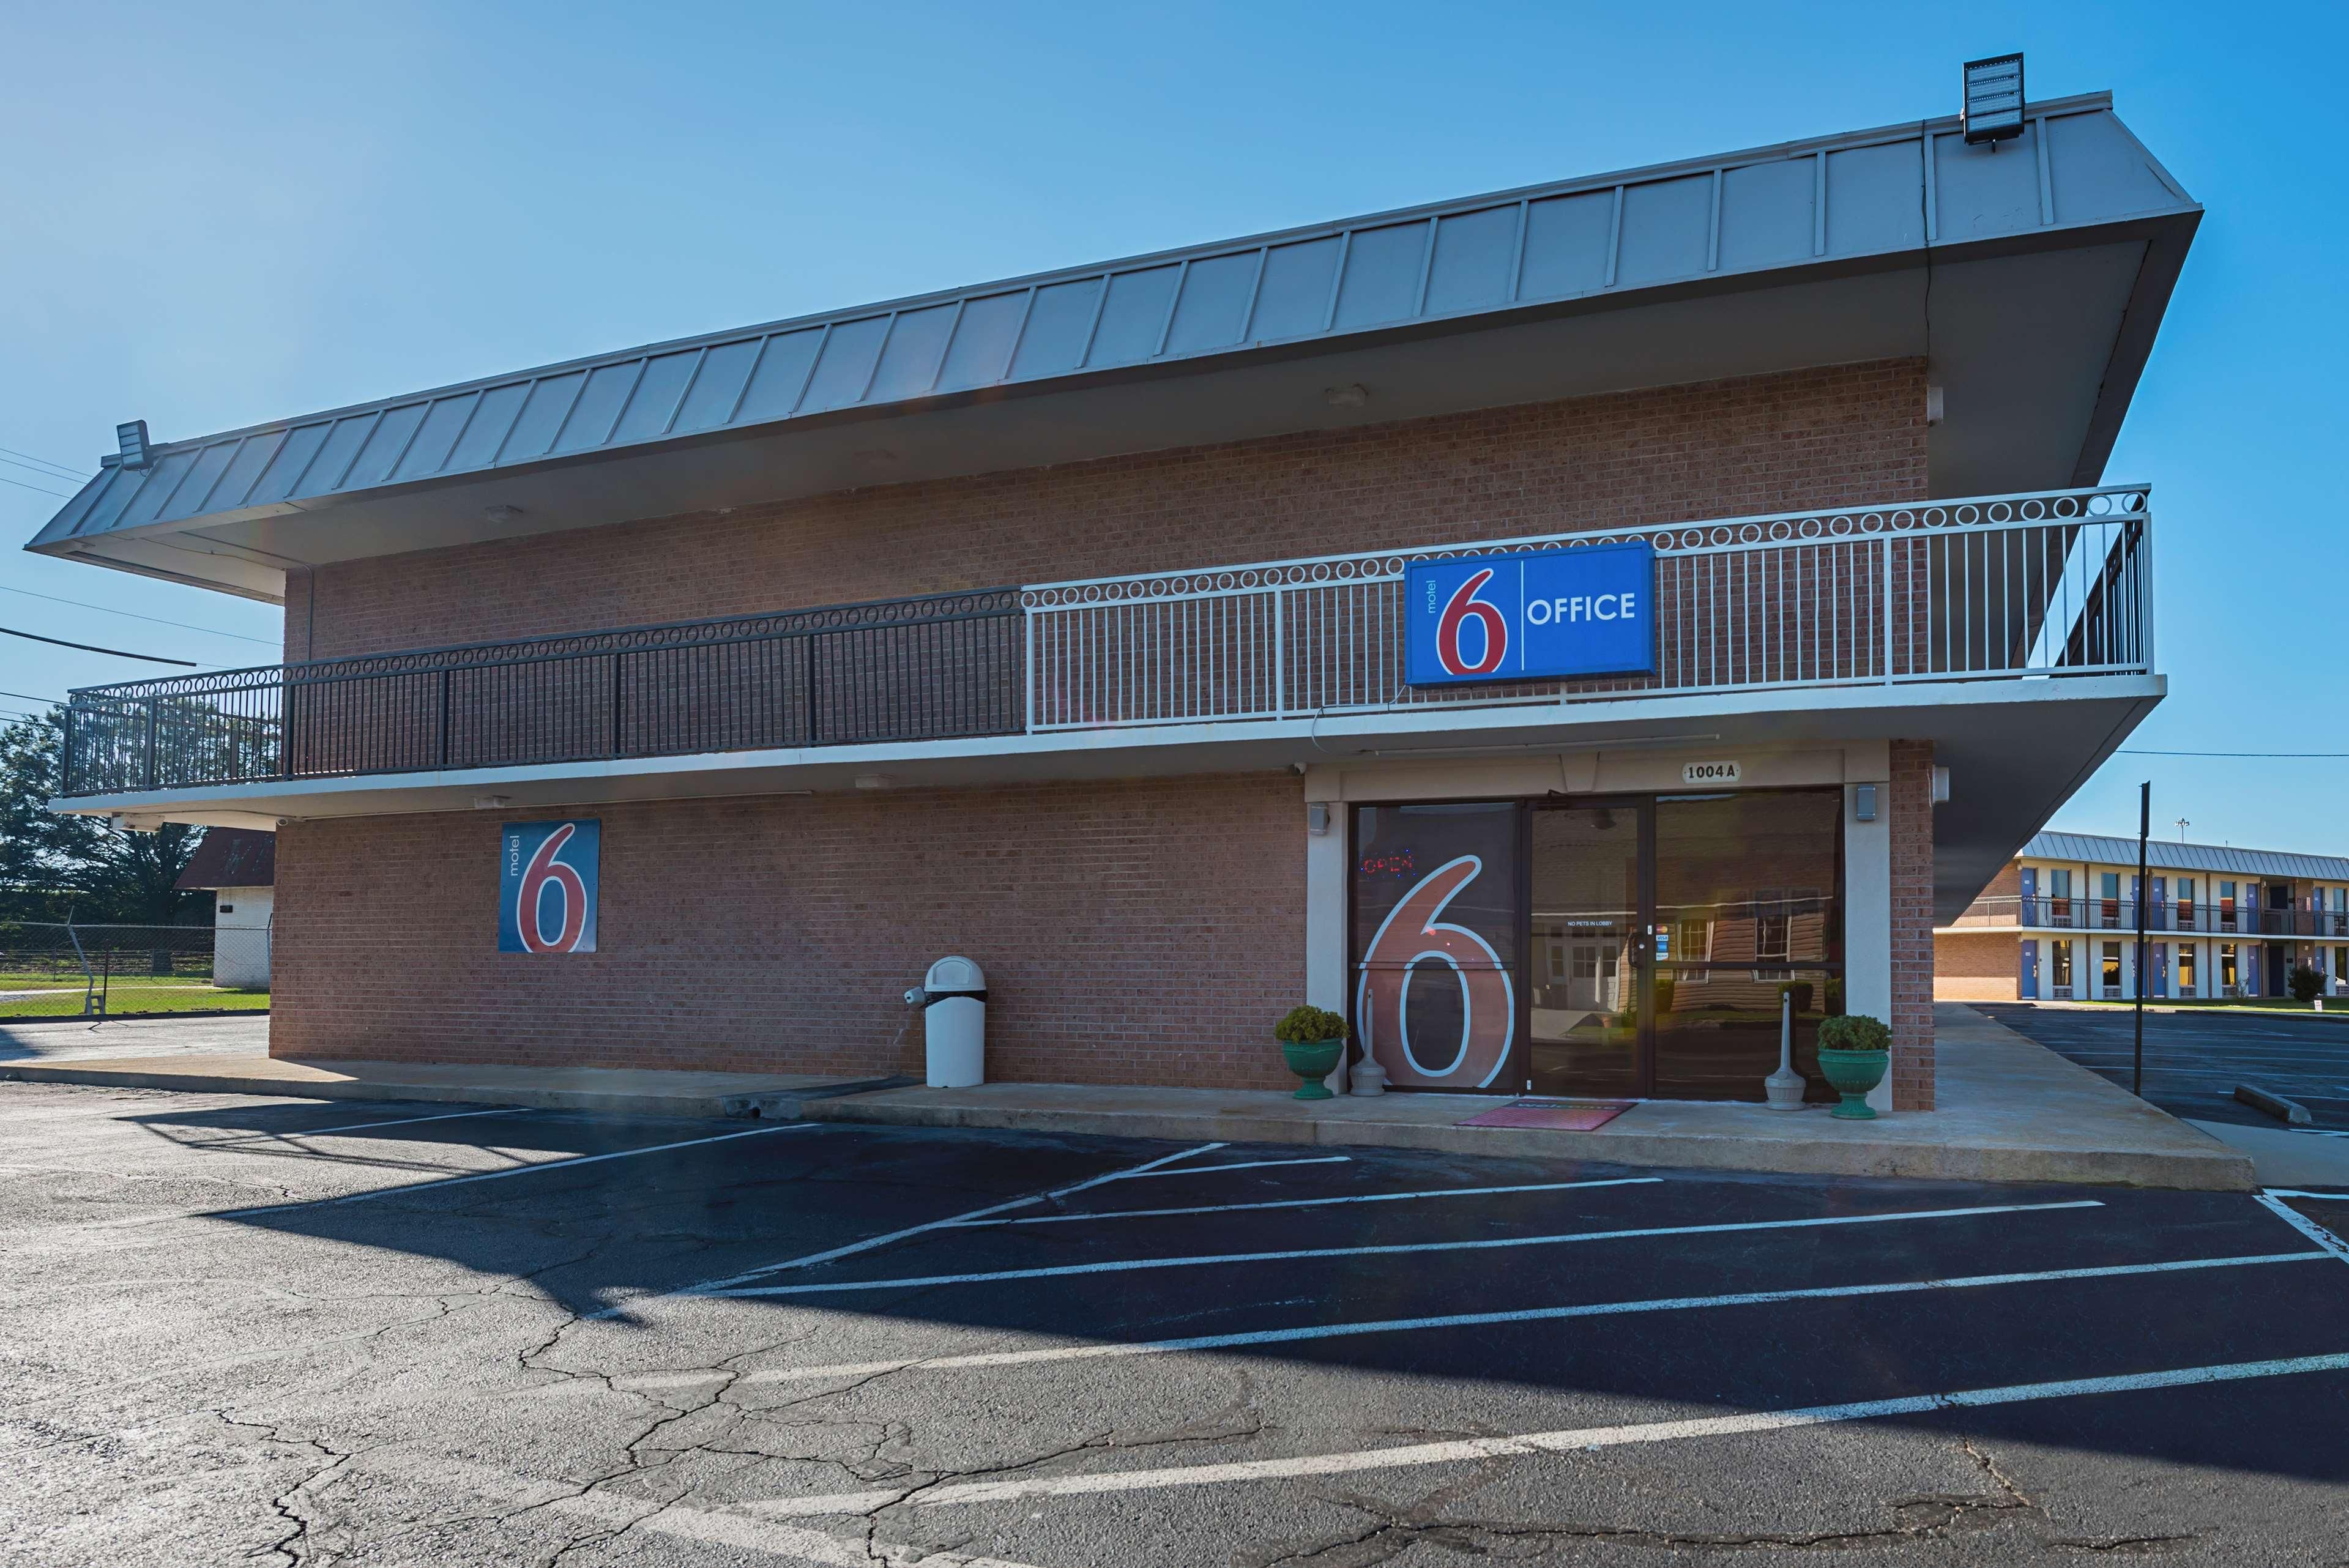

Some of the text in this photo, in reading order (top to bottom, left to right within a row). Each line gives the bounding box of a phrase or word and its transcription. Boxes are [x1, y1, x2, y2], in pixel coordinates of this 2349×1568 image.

[1426, 568, 1508, 675] motel 6
[1527, 592, 1635, 625] OFFICE
[510, 823, 587, 953] motel 6
[1364, 855, 1413, 875] OPEN
[1357, 855, 1514, 1088] 6
